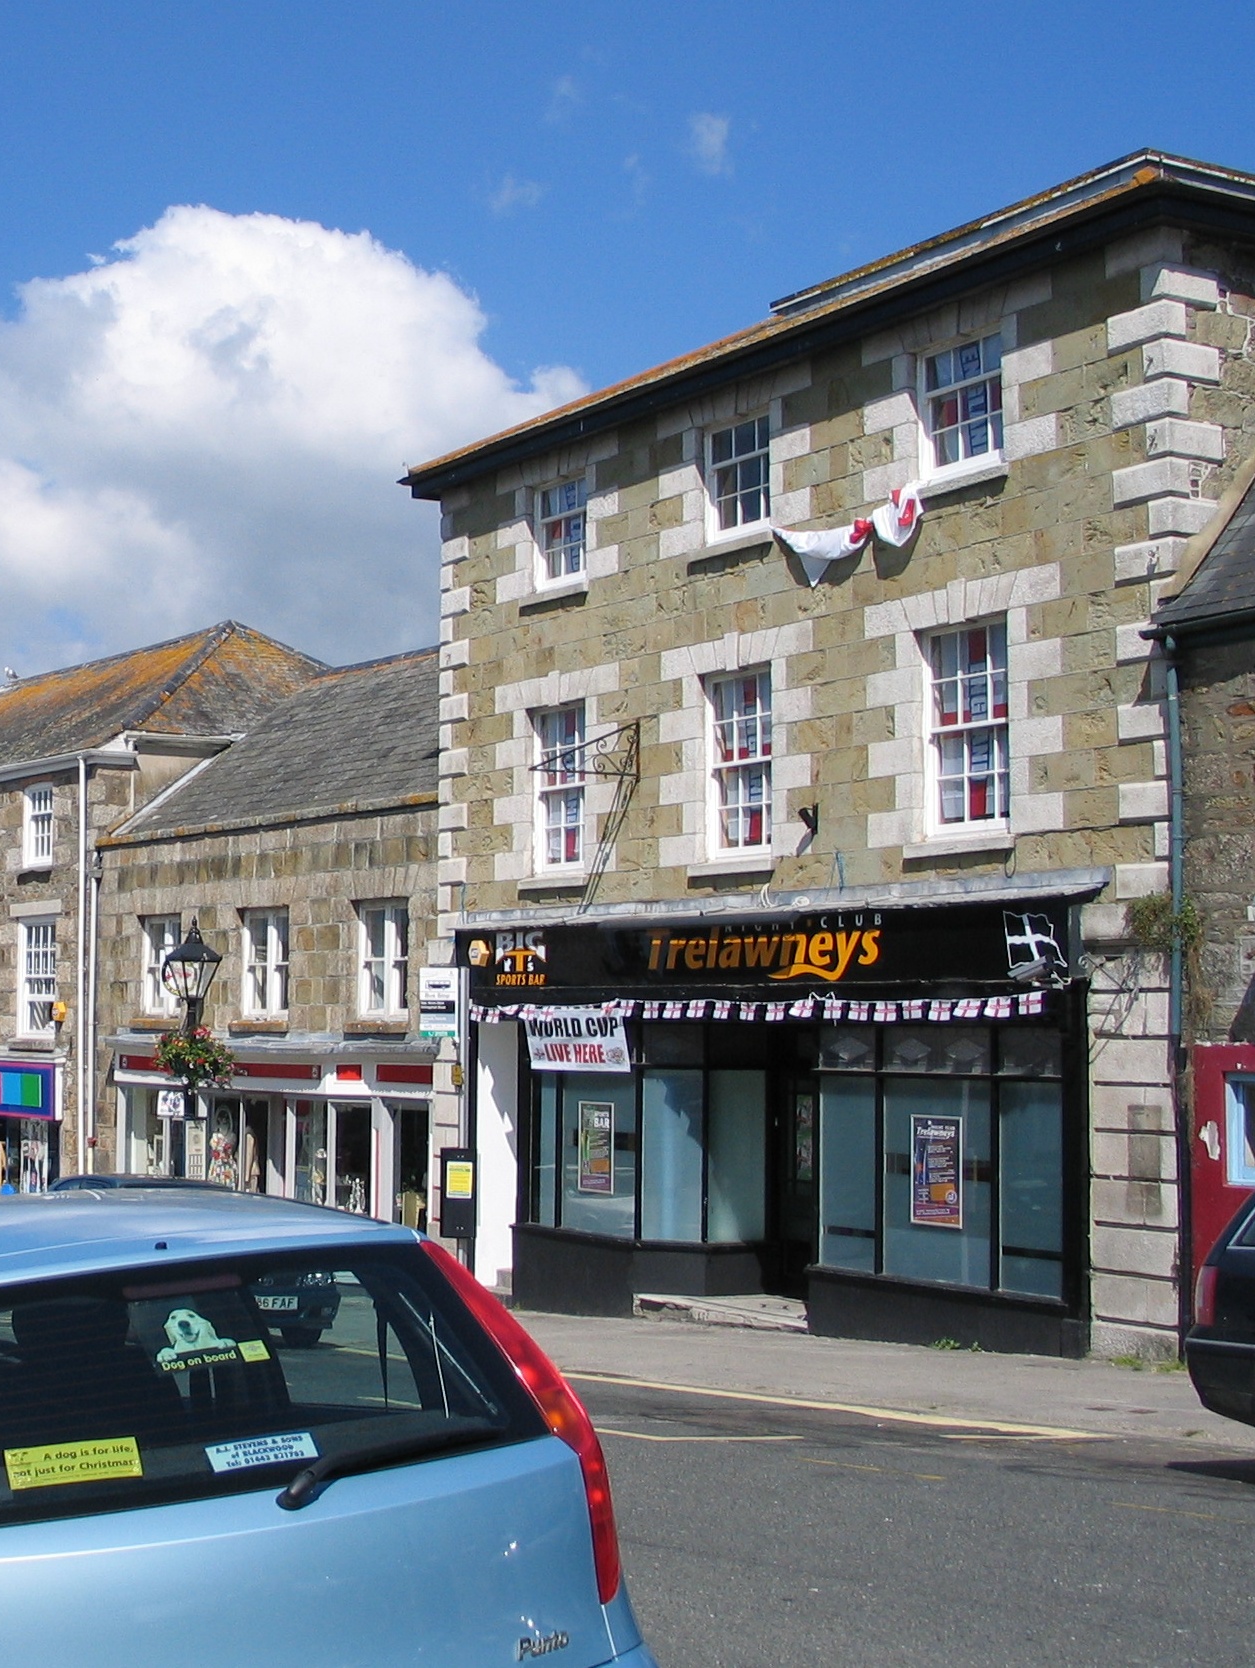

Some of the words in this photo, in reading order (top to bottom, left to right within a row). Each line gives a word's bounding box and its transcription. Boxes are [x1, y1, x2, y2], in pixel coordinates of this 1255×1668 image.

[821, 913, 882, 928] CLUB
[495, 931, 547, 959] BIG
[646, 927, 882, 981] Trelawneys
[495, 973, 525, 986] SPORTS
[528, 973, 546, 985] BAR
[529, 1016, 582, 1038] WORLD
[585, 1016, 618, 1038] CUP
[544, 1043, 571, 1062] LIVE
[573, 1043, 606, 1063] HERE
[594, 1117, 610, 1129] BAR
[271, 1297, 295, 1308] FAF
[161, 1360, 186, 1372] Dog
[187, 1357, 202, 1367] on
[203, 1350, 237, 1363] board
[233, 1440, 269, 1451] STEVENS
[242, 1444, 294, 1457] BLACKWOOD
[44, 1452, 52, 1461] A
[55, 1449, 77, 1459] dog
[80, 1447, 90, 1457] is
[93, 1446, 109, 1455] for
[34, 1465, 55, 1477] just
[59, 1464, 76, 1473] for
[516, 1630, 570, 1662] Punto
